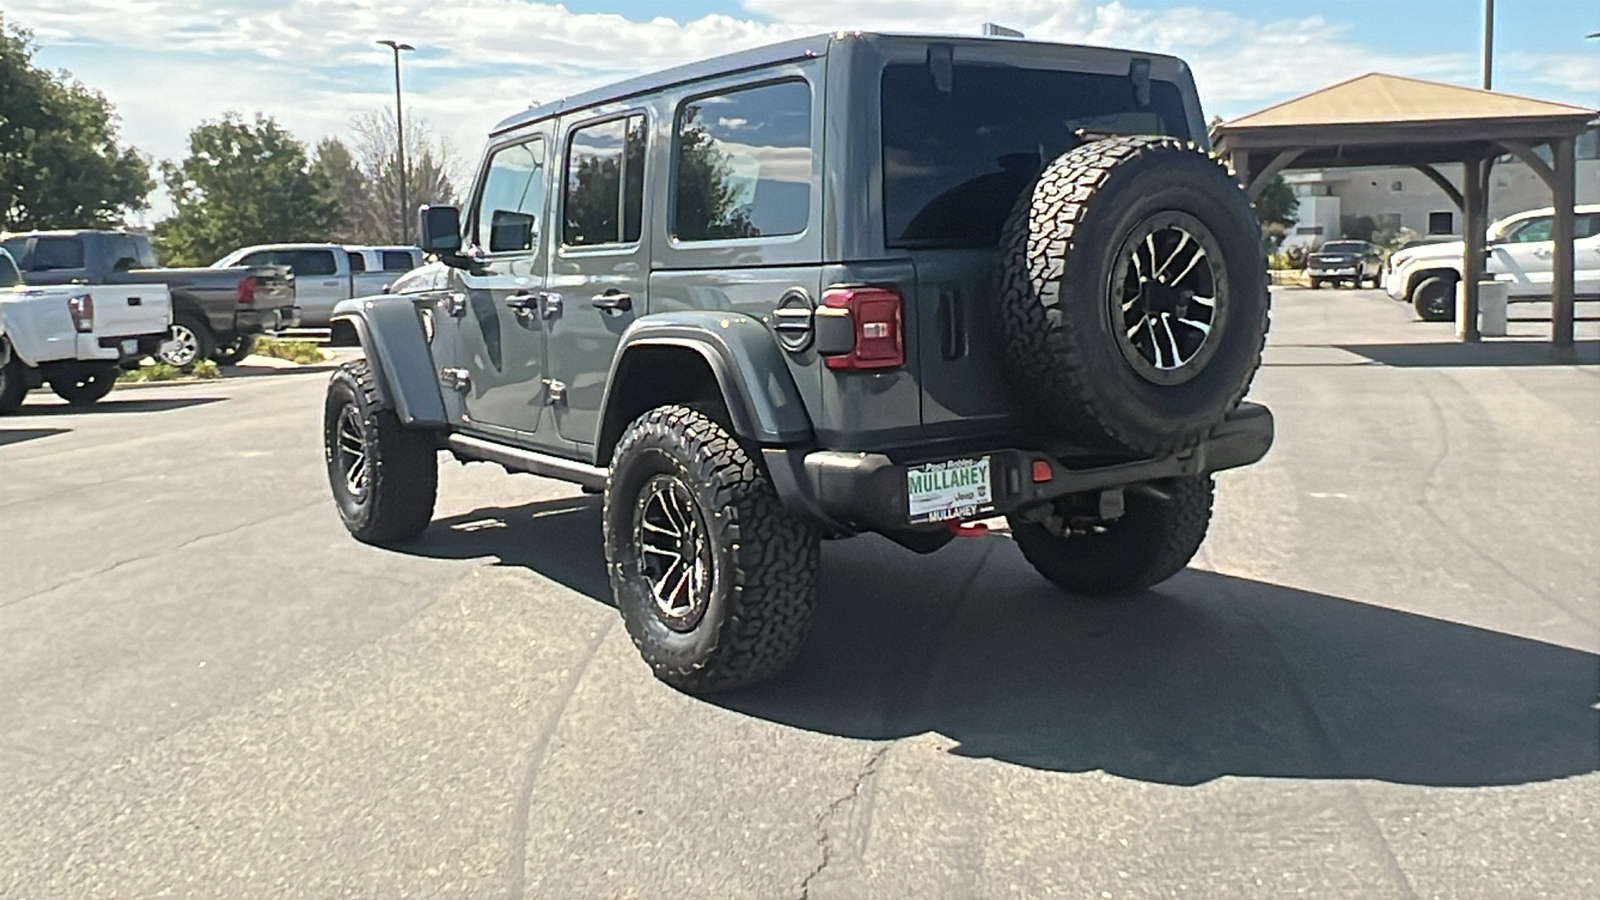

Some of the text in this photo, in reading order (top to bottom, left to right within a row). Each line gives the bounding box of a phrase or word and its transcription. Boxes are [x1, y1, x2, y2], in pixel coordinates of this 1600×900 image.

[909, 465, 987, 494] MULLAHEY
[953, 491, 974, 501] Jeep
[928, 504, 977, 522] MULLAHEY
